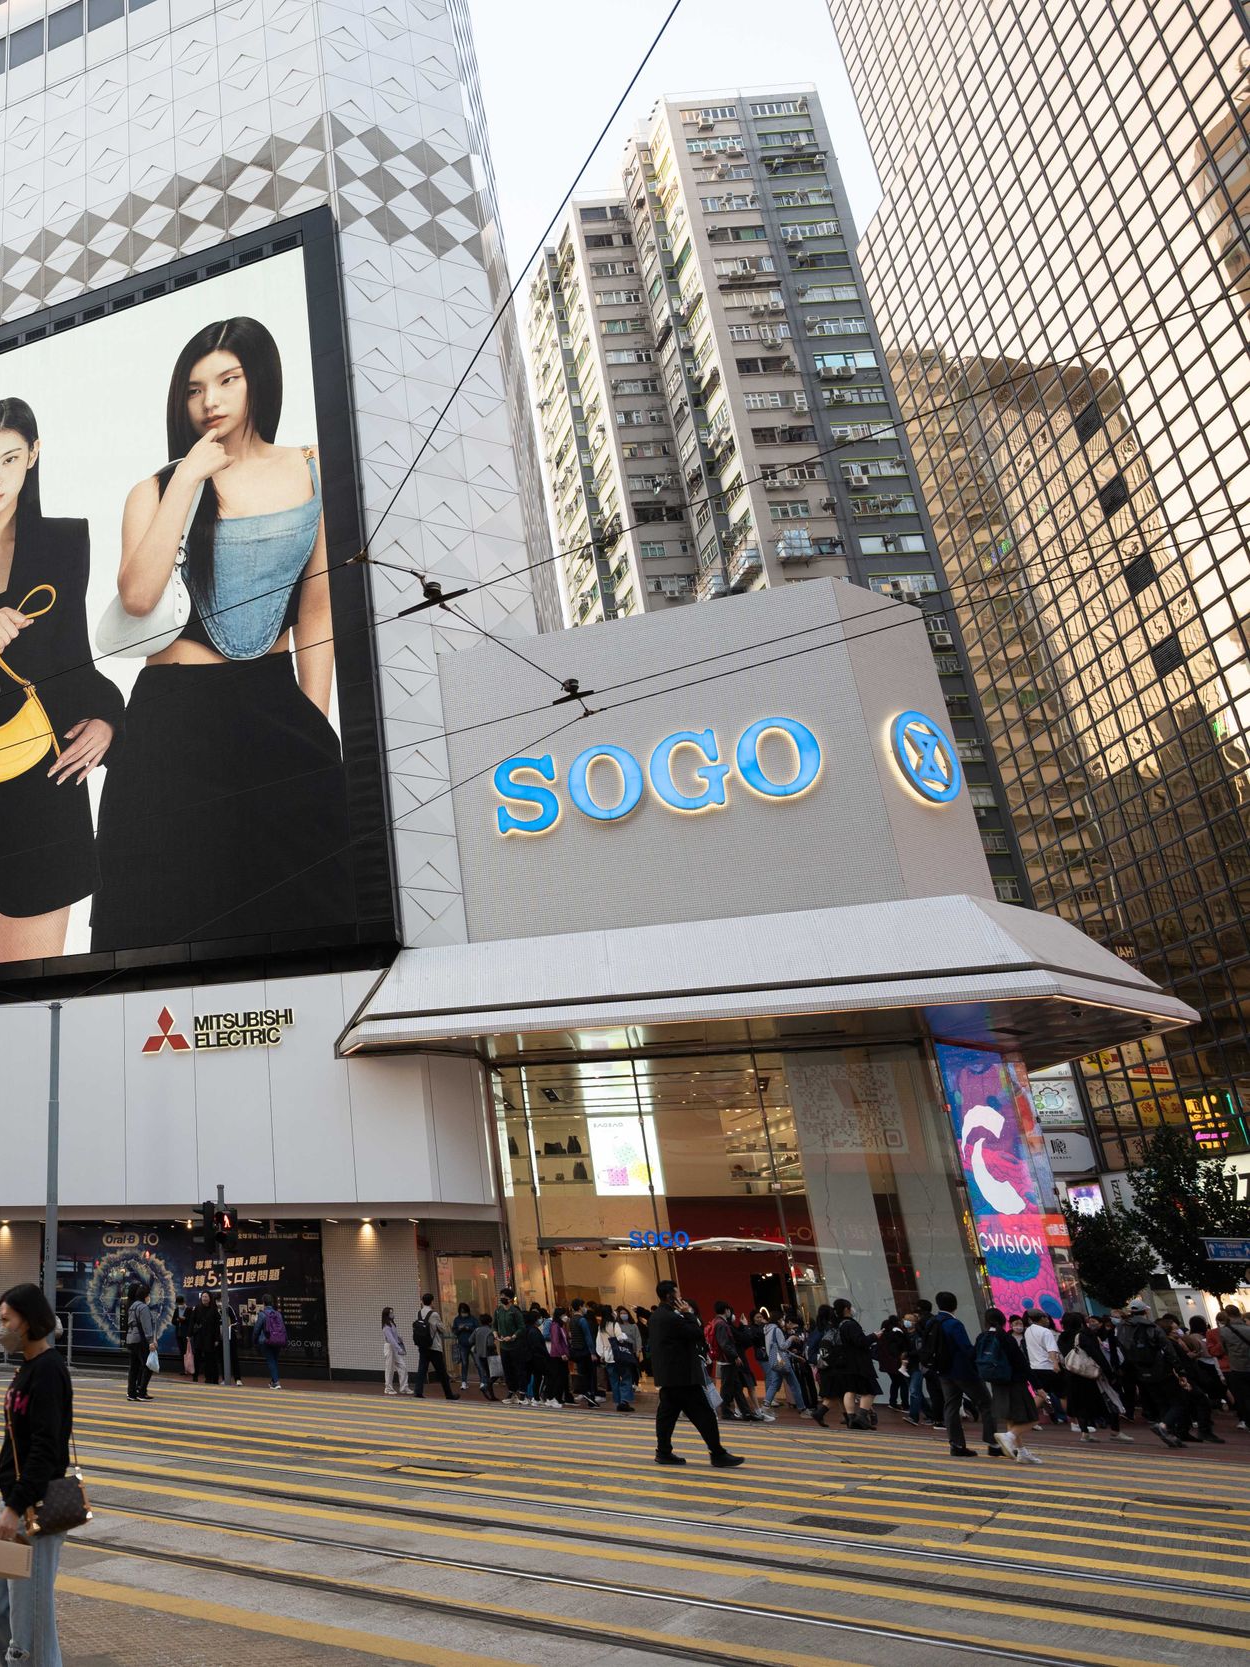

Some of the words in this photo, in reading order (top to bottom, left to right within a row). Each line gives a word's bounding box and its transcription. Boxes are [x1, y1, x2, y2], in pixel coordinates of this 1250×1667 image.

[494, 716, 821, 834] SOGO
[194, 1008, 293, 1031] MITSUBISHI
[194, 1027, 281, 1048] ELECTRIC
[105, 1234, 136, 1245] Oral-B
[629, 1230, 690, 1248] SOGO
[303, 1340, 322, 1348] CWB
